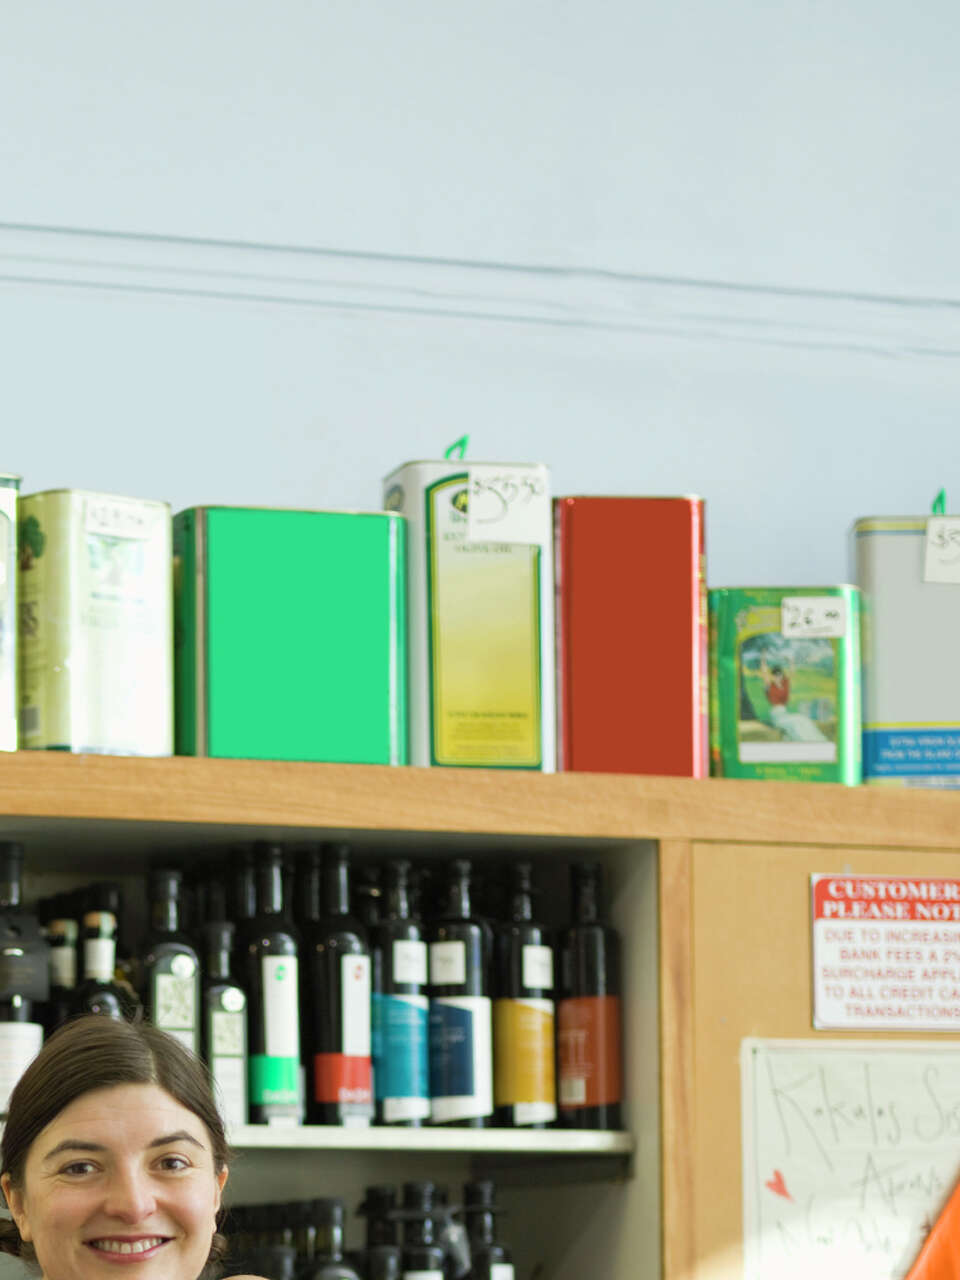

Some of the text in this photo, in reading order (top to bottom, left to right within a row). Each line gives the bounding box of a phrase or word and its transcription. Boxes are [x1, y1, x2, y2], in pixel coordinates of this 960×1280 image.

[823, 901, 911, 919] PLEASE
[824, 930, 855, 943] DUE
[861, 930, 881, 943] TO
[840, 949, 880, 961] BANK
[886, 950, 923, 962] FEES
[929, 950, 939, 962] A
[822, 967, 915, 979] SURCHARGE
[824, 985, 845, 998] TO
[849, 985, 873, 998] ALL
[880, 986, 934, 999] CREDIT
